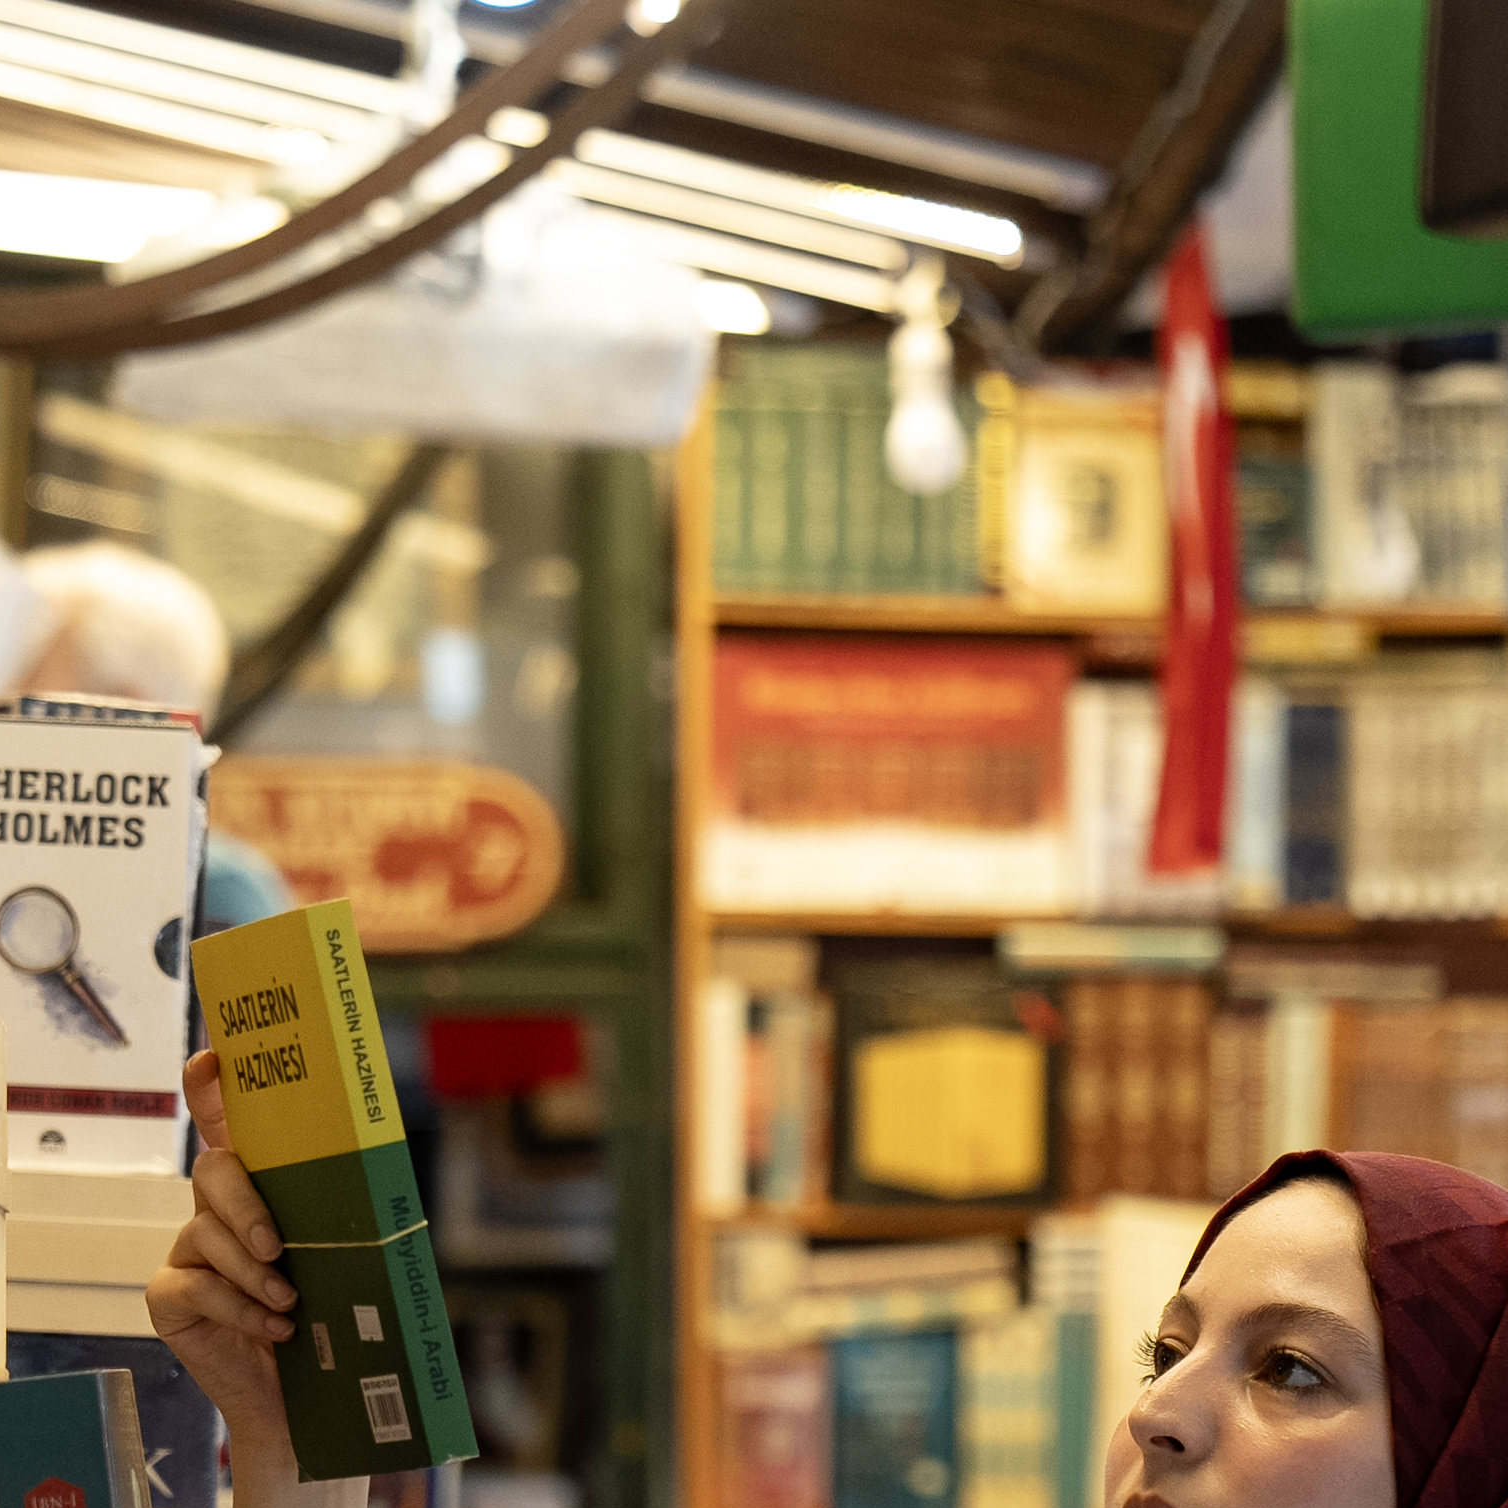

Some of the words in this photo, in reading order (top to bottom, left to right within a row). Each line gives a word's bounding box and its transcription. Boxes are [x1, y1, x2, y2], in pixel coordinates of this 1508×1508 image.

[219, 976, 300, 1039] SAATLERİN
[326, 928, 363, 1034] SAATLERİN
[351, 1036, 387, 1125] HAZİNESİ
[233, 1032, 309, 1095] HAZİNESİ
[422, 1336, 454, 1402] Arabi
